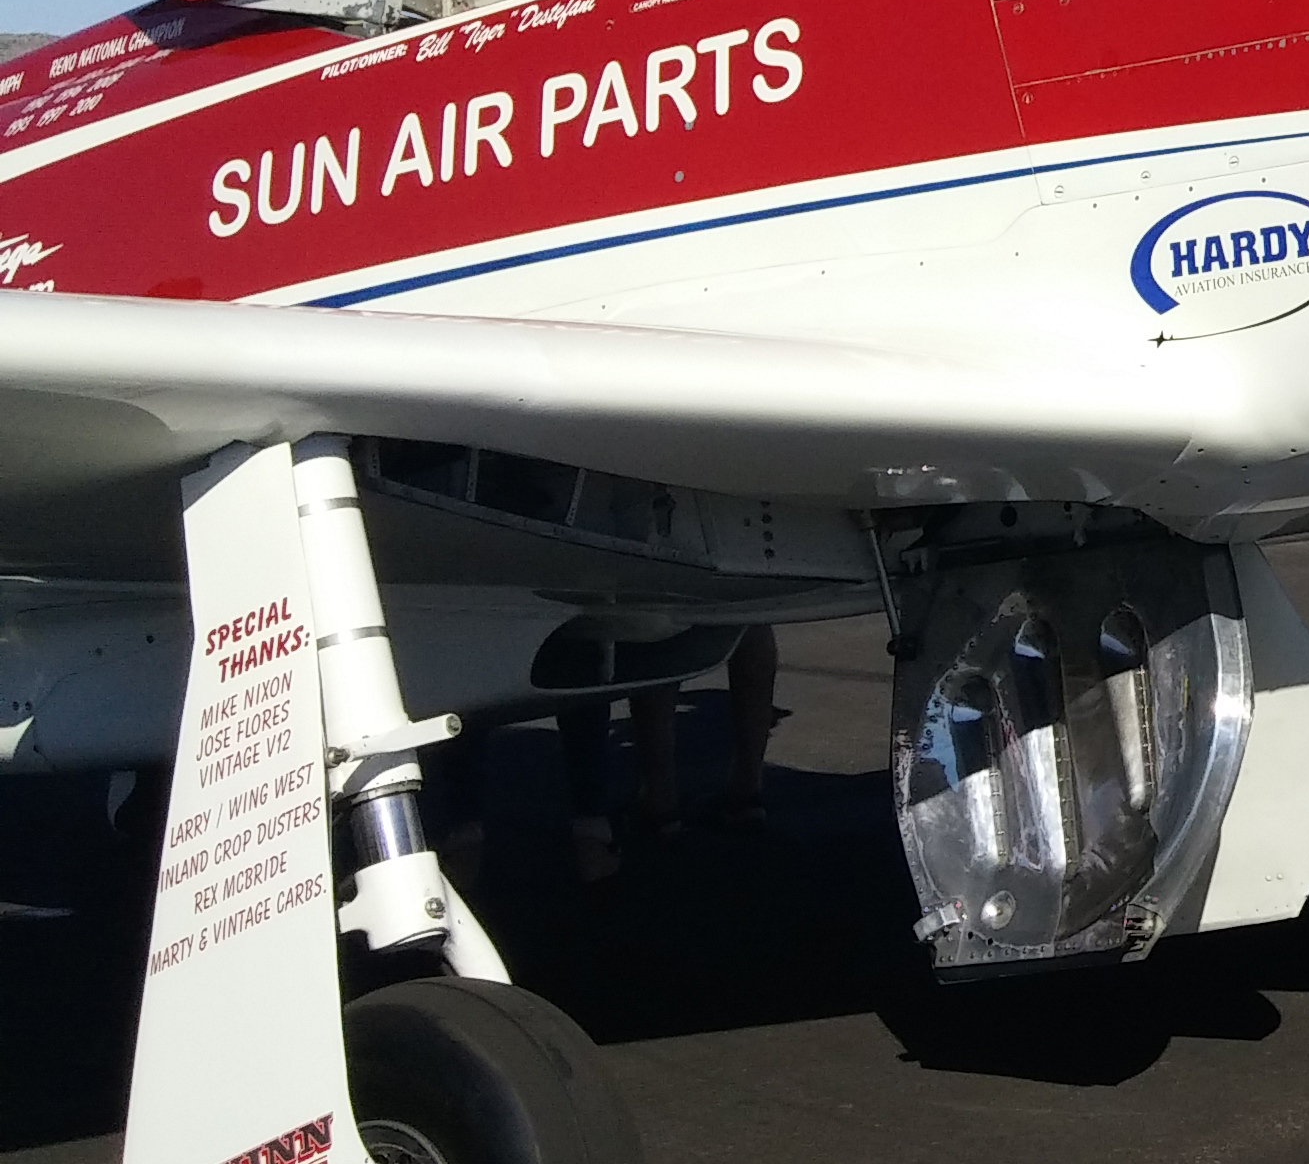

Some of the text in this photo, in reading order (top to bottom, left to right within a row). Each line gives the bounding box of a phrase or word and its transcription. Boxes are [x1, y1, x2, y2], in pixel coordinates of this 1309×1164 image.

[49, 53, 77, 79] RENO
[77, 35, 129, 69] NATIONAL
[128, 17, 187, 53] CHAMPION
[321, 43, 408, 81] PILOT/OWNER:
[415, 30, 455, 62] Bill
[207, 18, 803, 238] SUN AIR PARTS
[1174, 274, 1236, 298] AVIATION
[205, 597, 292, 656] SPECIAL
[218, 625, 311, 683] THANKS:
[196, 700, 291, 762] JOSE FLORES
[200, 669, 293, 731] MIKE NIXON
[199, 728, 292, 789] VINTAGE V12
[170, 809, 212, 849] LARRY
[229, 783, 269, 821] WING
[274, 762, 315, 799] WEST
[160, 797, 322, 893] INLAND CROP DUSTERS
[194, 850, 288, 915] REX MCBRIDE
[150, 873, 328, 976] MARTY & VINTAGE CARBS.
